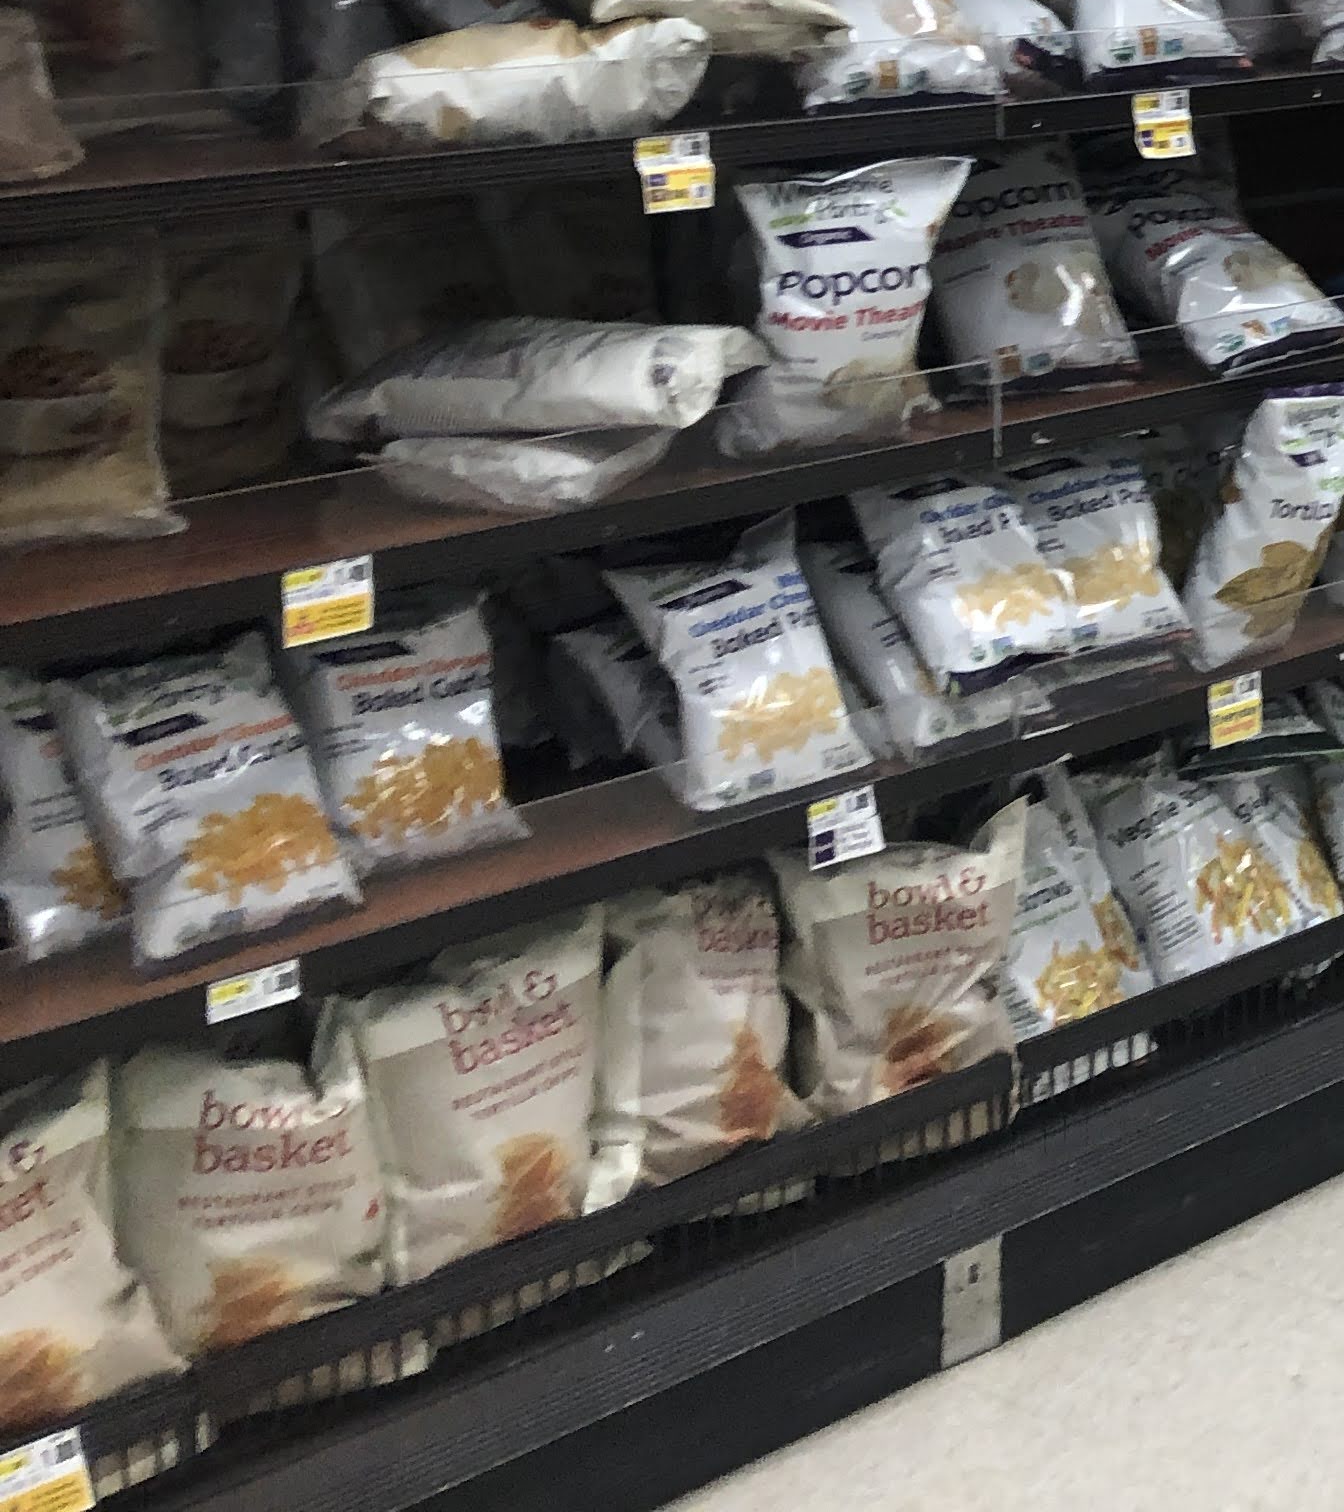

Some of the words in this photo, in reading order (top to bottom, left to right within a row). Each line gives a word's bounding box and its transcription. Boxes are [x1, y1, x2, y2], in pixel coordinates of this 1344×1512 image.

[950, 181, 1073, 222] opcorn
[777, 263, 928, 307] Popcor
[768, 310, 849, 333] Movie
[866, 900, 993, 947] basket
[193, 1127, 356, 1176] basket
